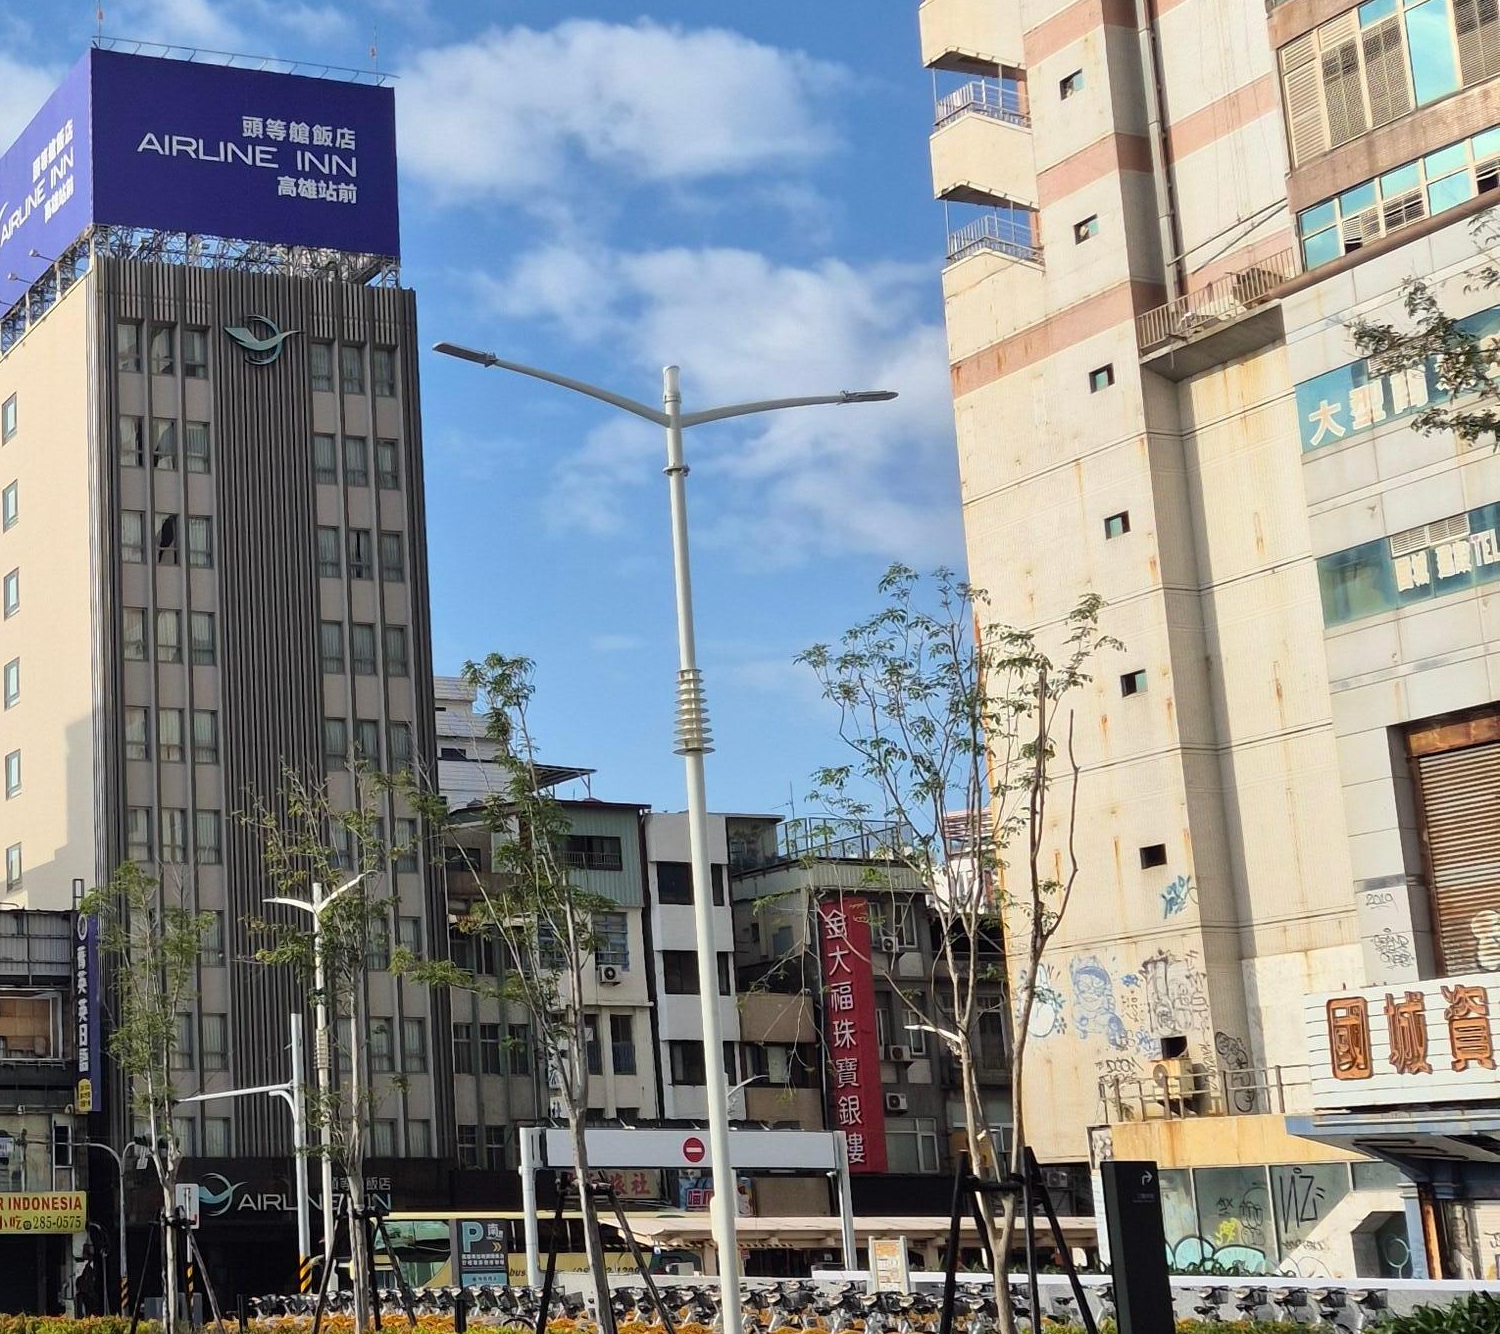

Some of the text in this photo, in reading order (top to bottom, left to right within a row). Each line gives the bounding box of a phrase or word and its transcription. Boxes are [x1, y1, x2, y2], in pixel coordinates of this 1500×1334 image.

[241, 116, 356, 151] 頭等艙飯店
[137, 133, 357, 178] AIRLINE INN
[0, 147, 74, 247] AIRLINE INN
[277, 176, 357, 204] 高雄站前
[824, 909, 866, 1165] 金大福珠寶銀樓
[8, 1196, 83, 1210] INDONESIA
[33, 1215, 82, 1230] 285-0575
[462, 1221, 484, 1253] P
